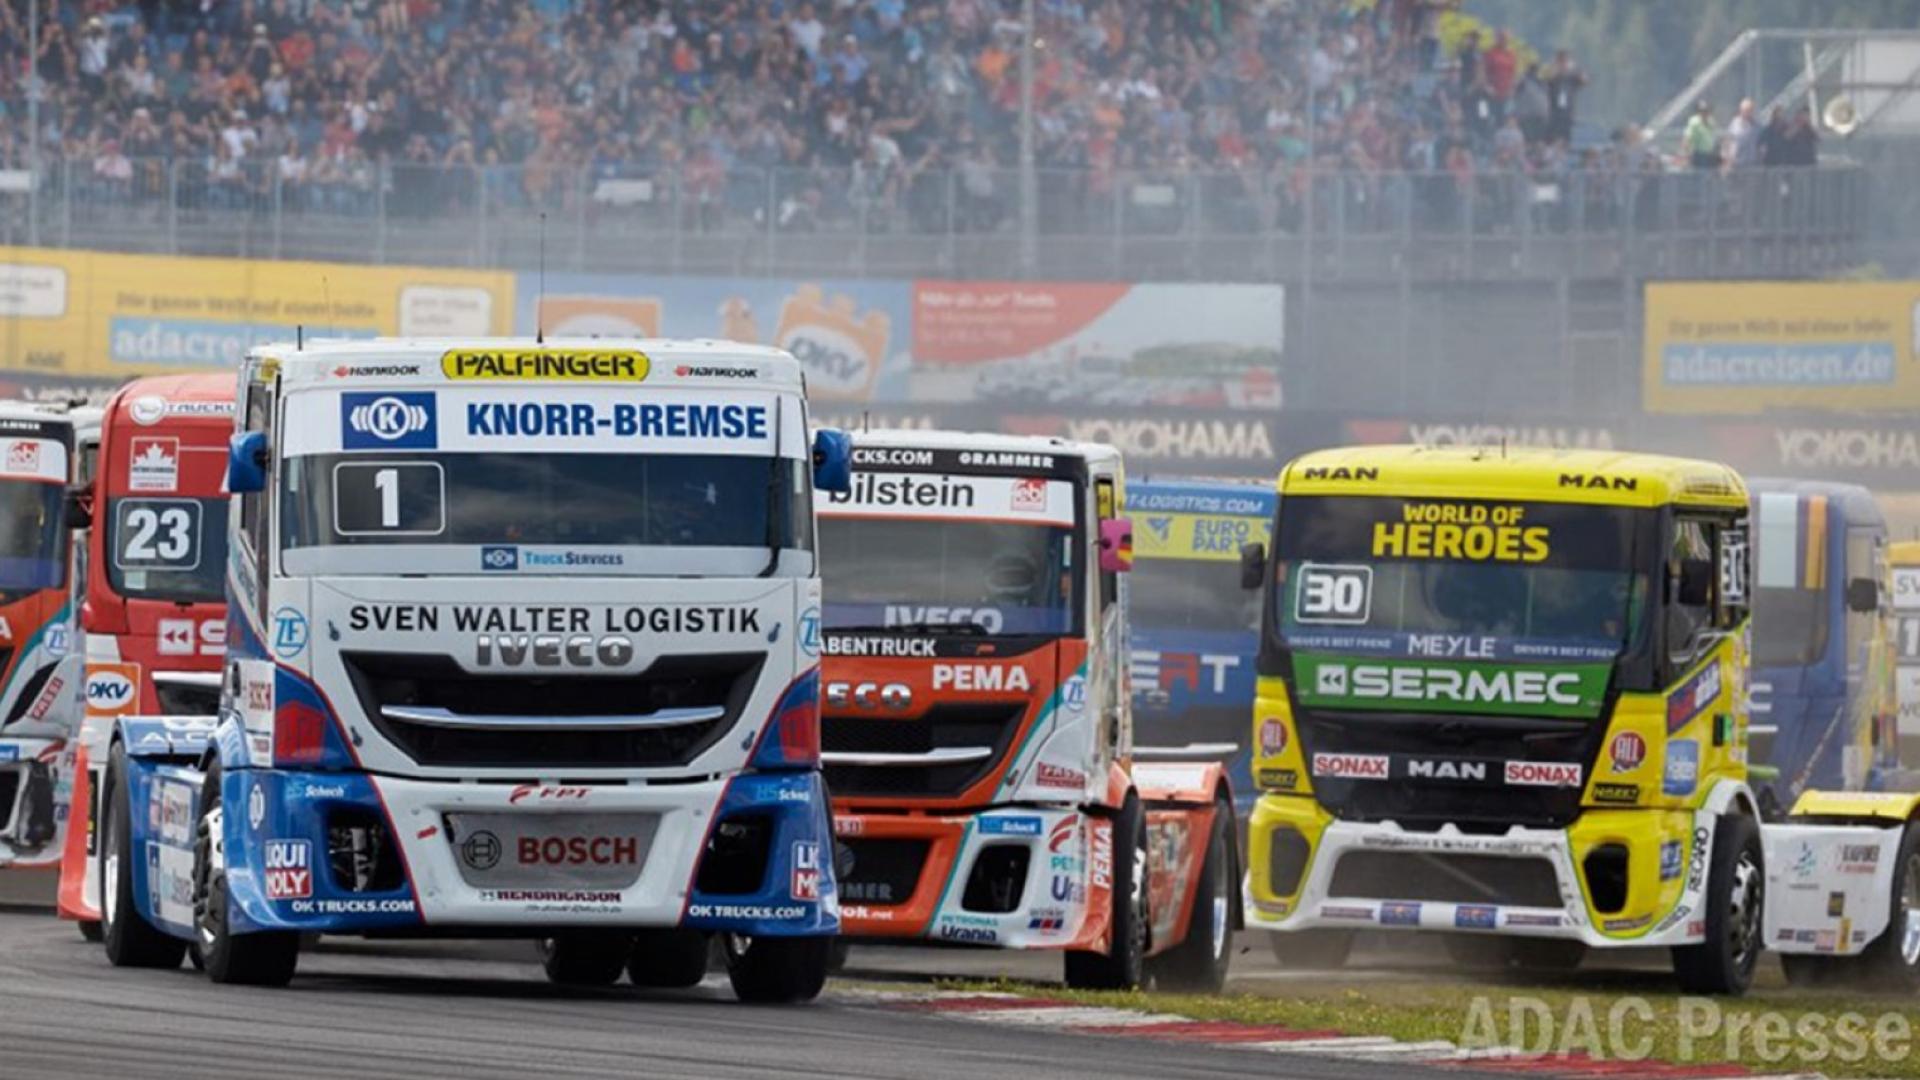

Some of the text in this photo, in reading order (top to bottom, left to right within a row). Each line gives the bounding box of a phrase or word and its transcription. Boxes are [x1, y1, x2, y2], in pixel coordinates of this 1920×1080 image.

[457, 353, 635, 378] PALFINGER
[788, 335, 866, 381] DKV
[1668, 346, 1892, 382] adacreisen.de
[467, 403, 768, 440] KNORR-BREMSE
[1068, 420, 1274, 459] YOKOHAMA
[959, 452, 1054, 468] GRAMMER
[1304, 467, 1379, 480] MAN
[1558, 474, 1637, 490] MAN
[374, 469, 399, 526] 1
[1194, 520, 1250, 536] EURO
[1403, 504, 1524, 525] WORLD OF
[124, 508, 191, 559] 23
[1372, 523, 1550, 562] HEROES
[1304, 573, 1364, 613] 30
[274, 618, 302, 648] ZF
[350, 605, 760, 633] SVEN WALTER LOGISTIK
[884, 605, 1003, 634] IVECO
[200, 620, 226, 655] S
[476, 634, 634, 667] IVECO
[1408, 634, 1496, 658] MEYLE
[932, 665, 1031, 691] PEMA
[1353, 665, 1580, 704] SERMEC
[1315, 757, 1386, 775] SONAX
[1408, 761, 1486, 779] MAN
[1508, 765, 1578, 783] SONAX
[540, 788, 592, 799] FPT
[517, 836, 637, 865] BOSCH
[1093, 825, 1112, 889] PEMA
[292, 900, 415, 913] OK TRUCKS.COM
[689, 905, 712, 917] OK
[942, 924, 997, 941] Urania
